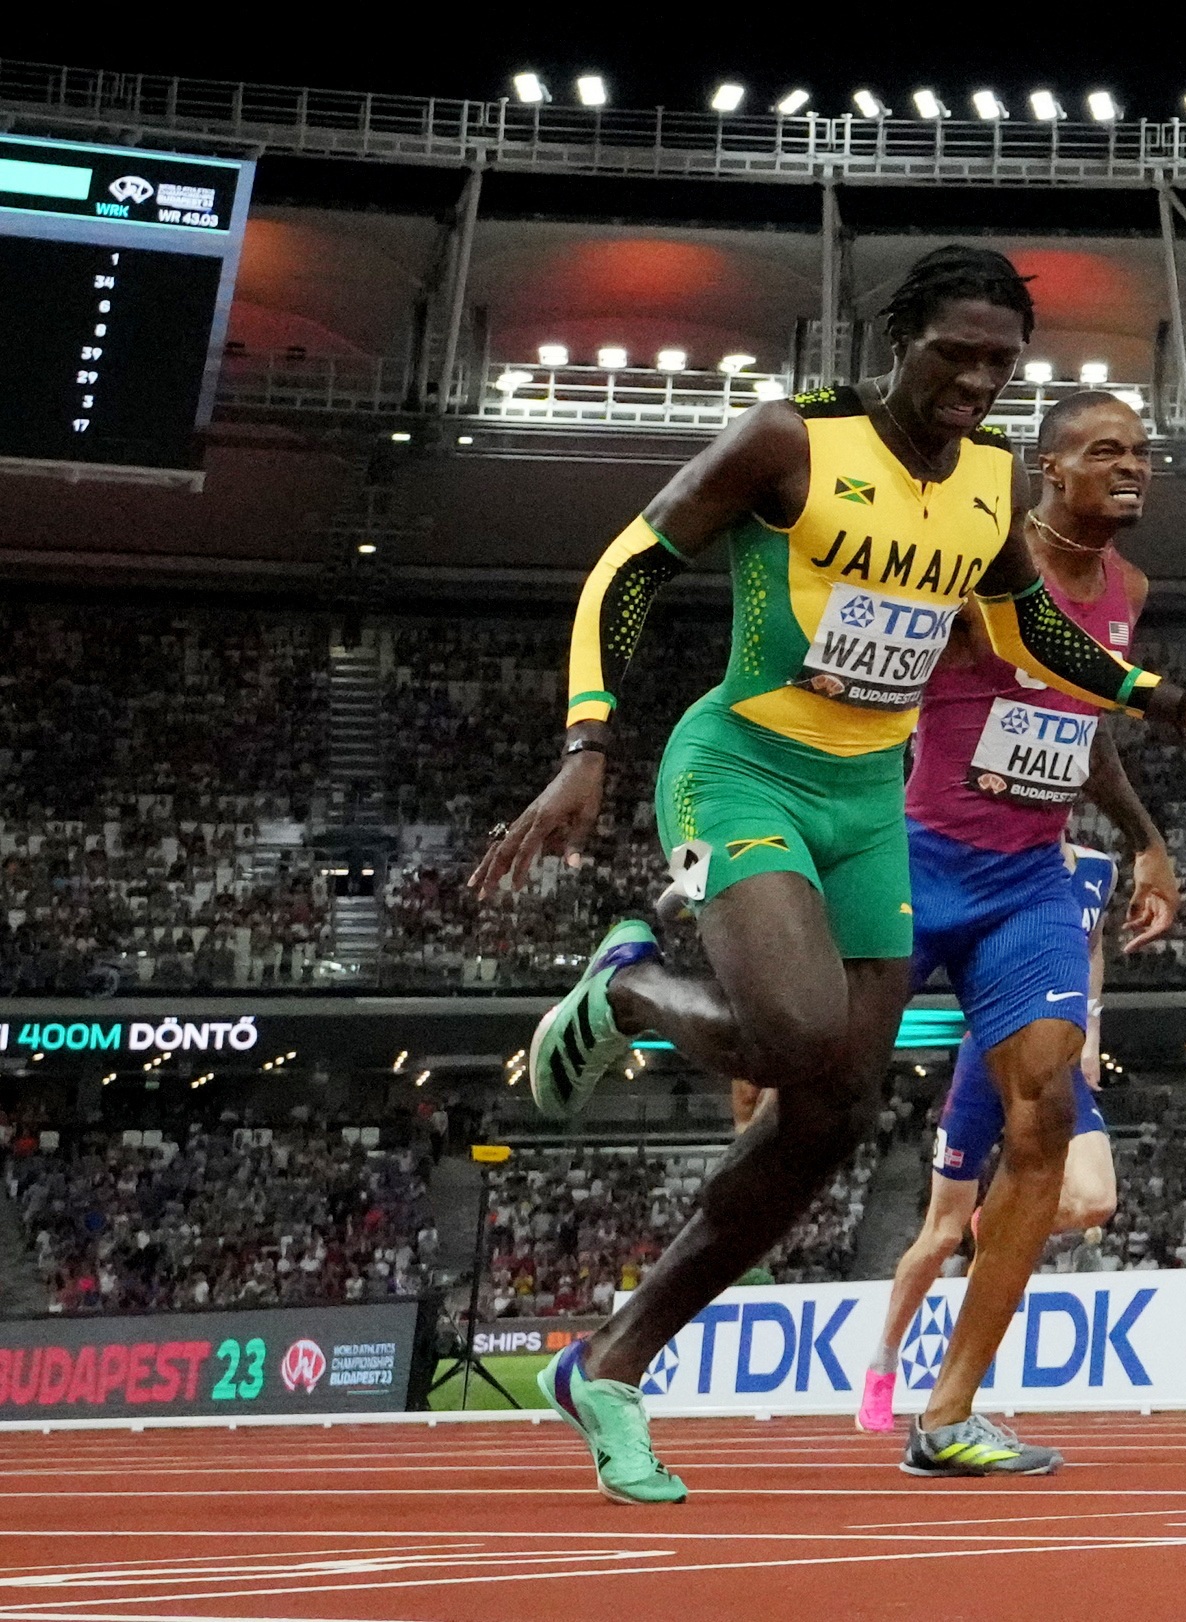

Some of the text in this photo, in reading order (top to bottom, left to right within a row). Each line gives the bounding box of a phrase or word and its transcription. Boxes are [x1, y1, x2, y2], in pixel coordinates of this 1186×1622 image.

[96, 202, 129, 218] WRK
[159, 209, 181, 223] WR
[111, 252, 120, 266] 1
[94, 275, 115, 290] 34
[72, 419, 90, 433] 17
[811, 530, 984, 598] JAMAIC
[879, 601, 954, 640] TDK
[821, 631, 943, 681] WATSON
[1034, 711, 1094, 746] TDK
[1007, 744, 1074, 782] HALL
[18, 1023, 122, 1050] 400M
[129, 1016, 258, 1050] DÖNTŐ
[688, 1299, 859, 1393] TDK
[980, 1287, 1159, 1389] DK
[212, 1337, 266, 1400] 23
[329, 1370, 380, 1386] BUDAPEST
